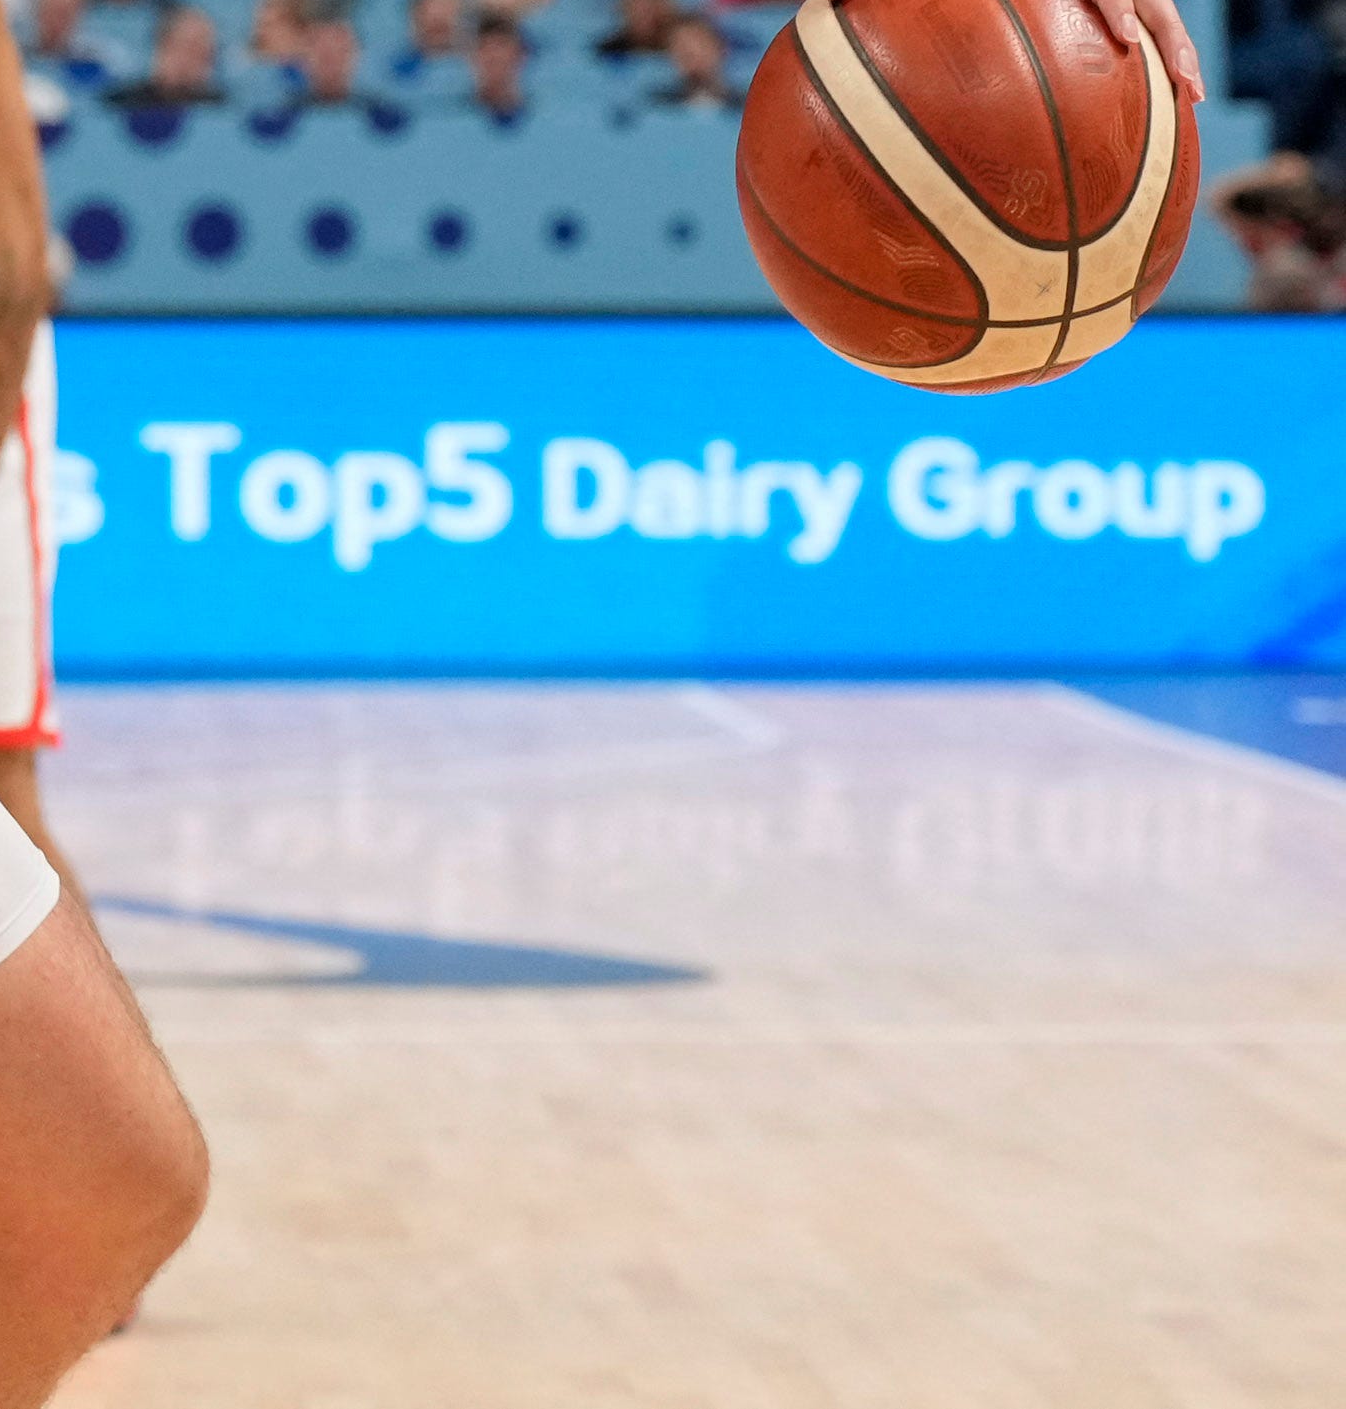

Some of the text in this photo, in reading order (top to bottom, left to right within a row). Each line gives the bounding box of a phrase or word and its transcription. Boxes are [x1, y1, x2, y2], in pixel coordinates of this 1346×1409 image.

[138, 421, 515, 573] Top5
[542, 436, 864, 565] Dairy
[887, 435, 1267, 564] Group
